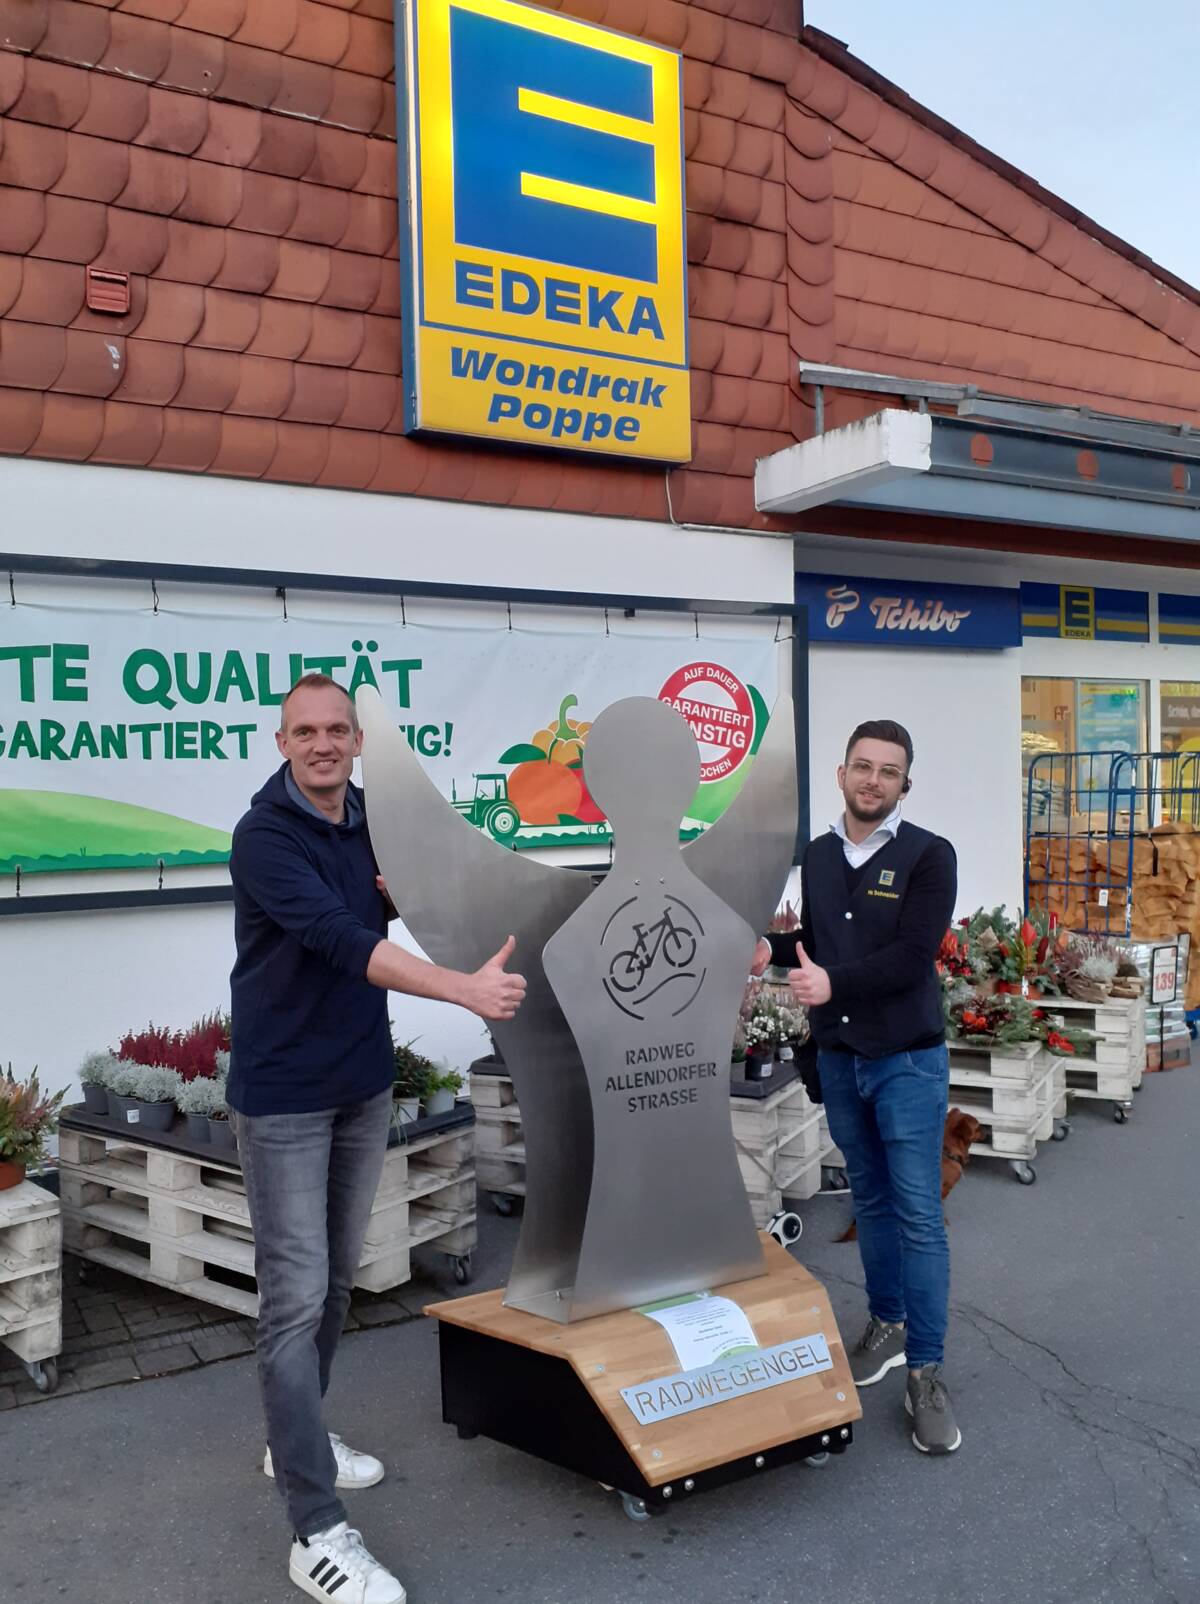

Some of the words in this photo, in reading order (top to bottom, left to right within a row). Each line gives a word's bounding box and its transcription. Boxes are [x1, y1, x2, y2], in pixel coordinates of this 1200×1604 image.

[455, 259, 665, 341] EDEKA
[451, 346, 668, 408] Wondrak
[487, 393, 641, 442] Poppe
[869, 597, 971, 632] Tchibo
[1065, 629, 1091, 638] EDEKA
[684, 667, 704, 681] AUF
[706, 667, 739, 693] DAUER
[0, 719, 257, 760] ARANTIERT
[626, 1042, 695, 1065] RADWEG
[605, 1062, 717, 1092] ALLENDORFER
[628, 1088, 699, 1113] STRASSE
[634, 1344, 829, 1416] RADWEGENGEL
